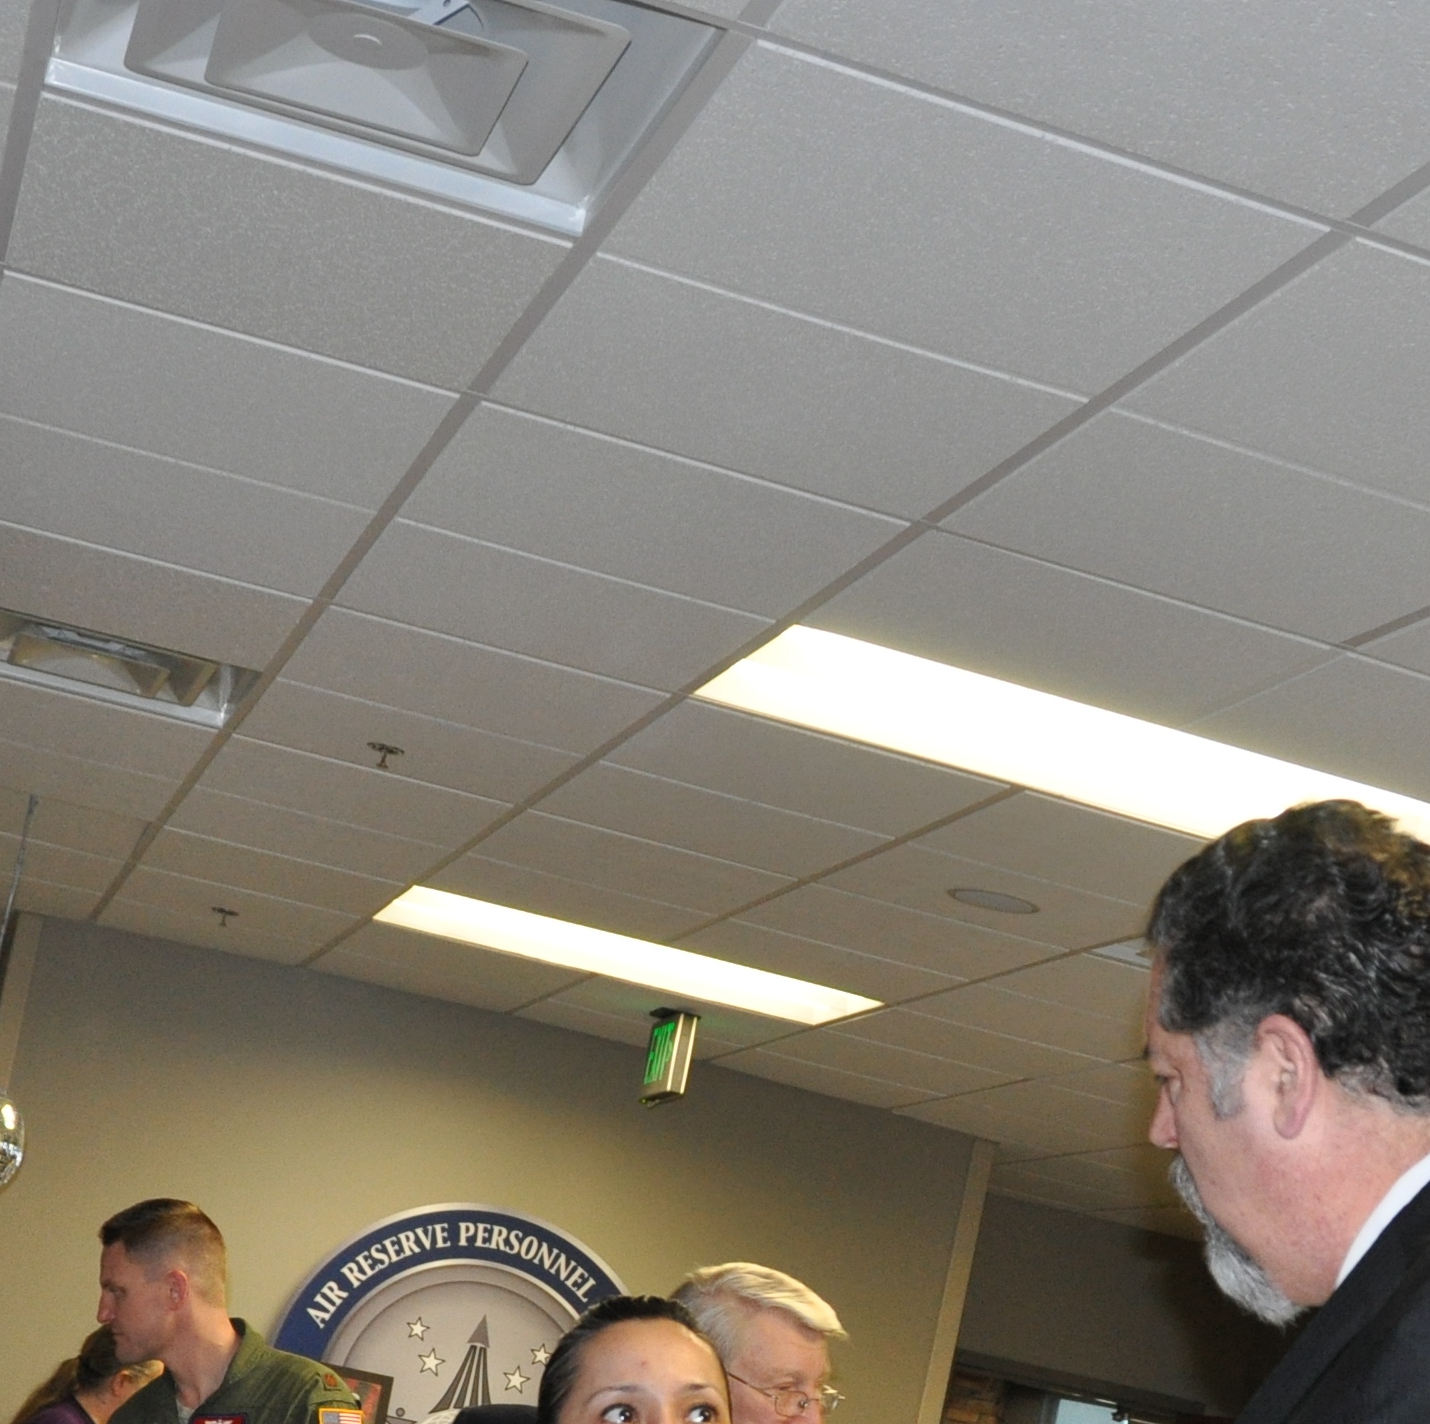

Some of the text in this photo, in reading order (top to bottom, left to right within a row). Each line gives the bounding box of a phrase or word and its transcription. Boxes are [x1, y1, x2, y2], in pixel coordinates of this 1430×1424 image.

[306, 1222, 597, 1329] AIR RESERVE PERSONNEL
